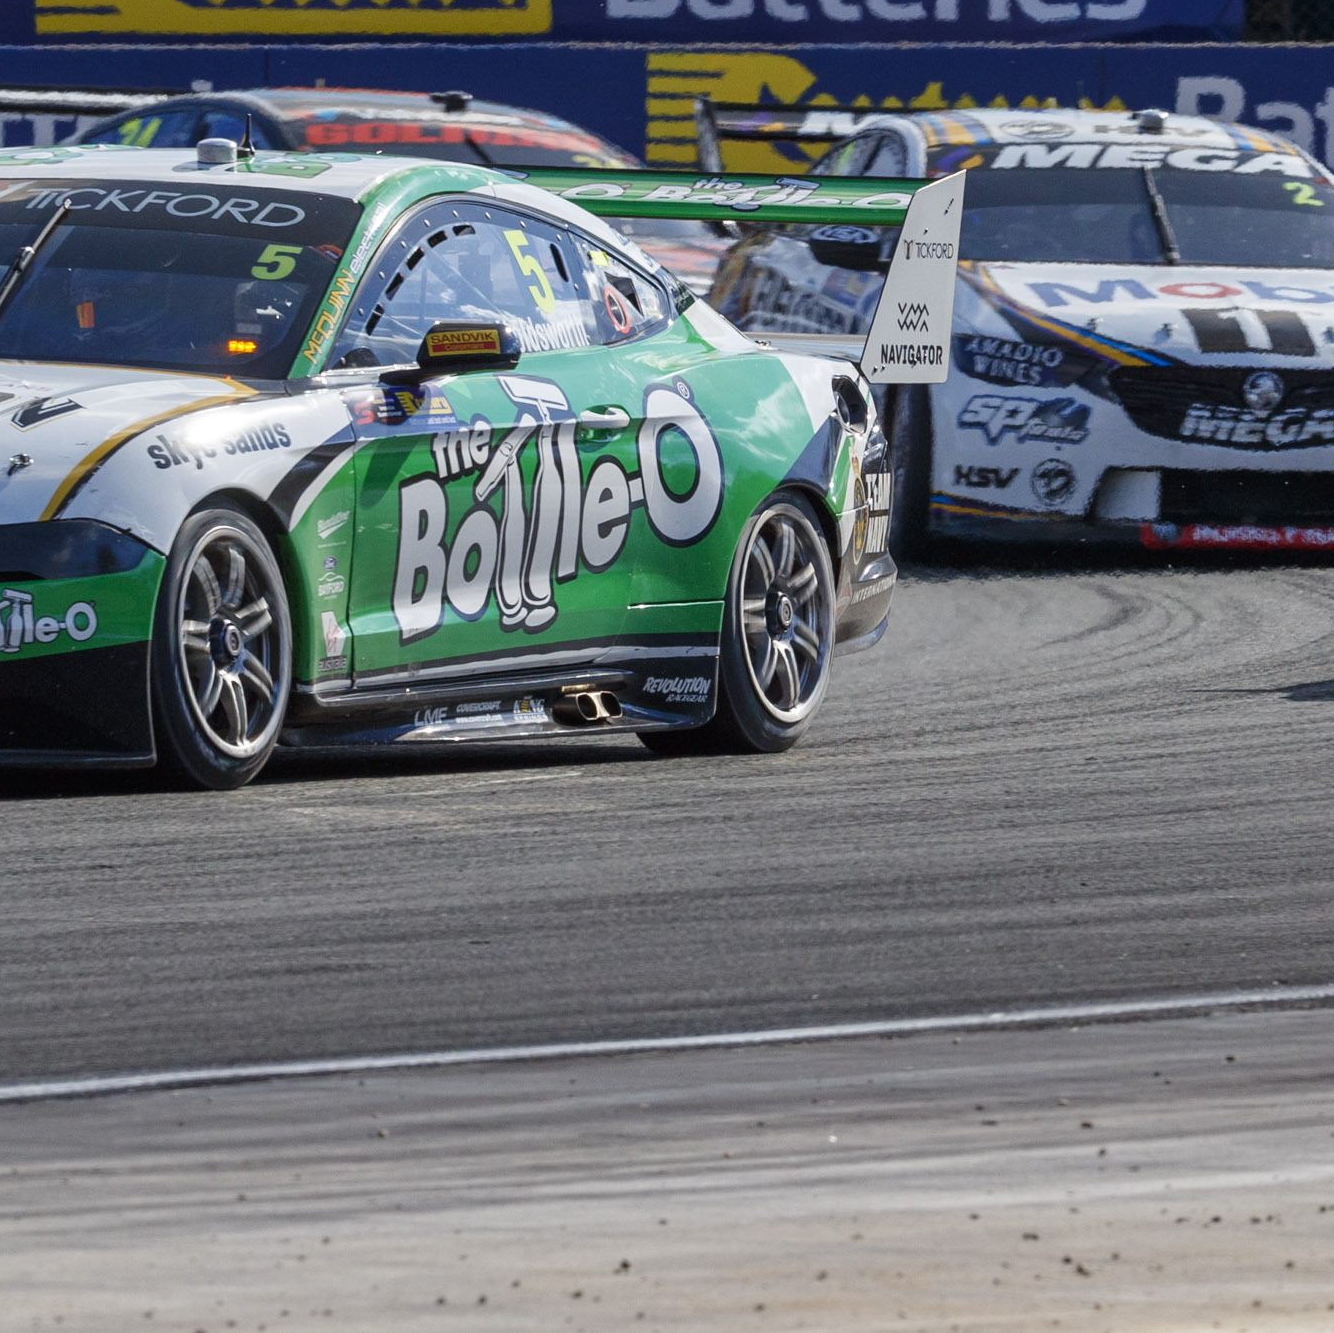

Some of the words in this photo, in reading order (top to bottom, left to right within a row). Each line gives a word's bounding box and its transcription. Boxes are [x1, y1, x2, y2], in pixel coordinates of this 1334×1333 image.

[991, 143, 1314, 179] MEGA
[24, 186, 307, 228] TICKFORD
[1282, 180, 1325, 208] 2
[250, 243, 304, 281] 5
[502, 229, 556, 314] 5
[429, 329, 496, 346] SANDVIK
[964, 336, 1064, 368] AMADIO
[880, 344, 944, 367] NAVIGATOR
[972, 354, 1044, 386] WINES
[220, 417, 292, 458] sands
[431, 419, 494, 480] the
[952, 465, 1019, 488] HSV
[393, 374, 724, 642] Bottle-O
[642, 676, 712, 696] REVOLUTION
[665, 692, 709, 704] RACEGEAR
[414, 706, 449, 727] LMF
[513, 696, 545, 714] KING
